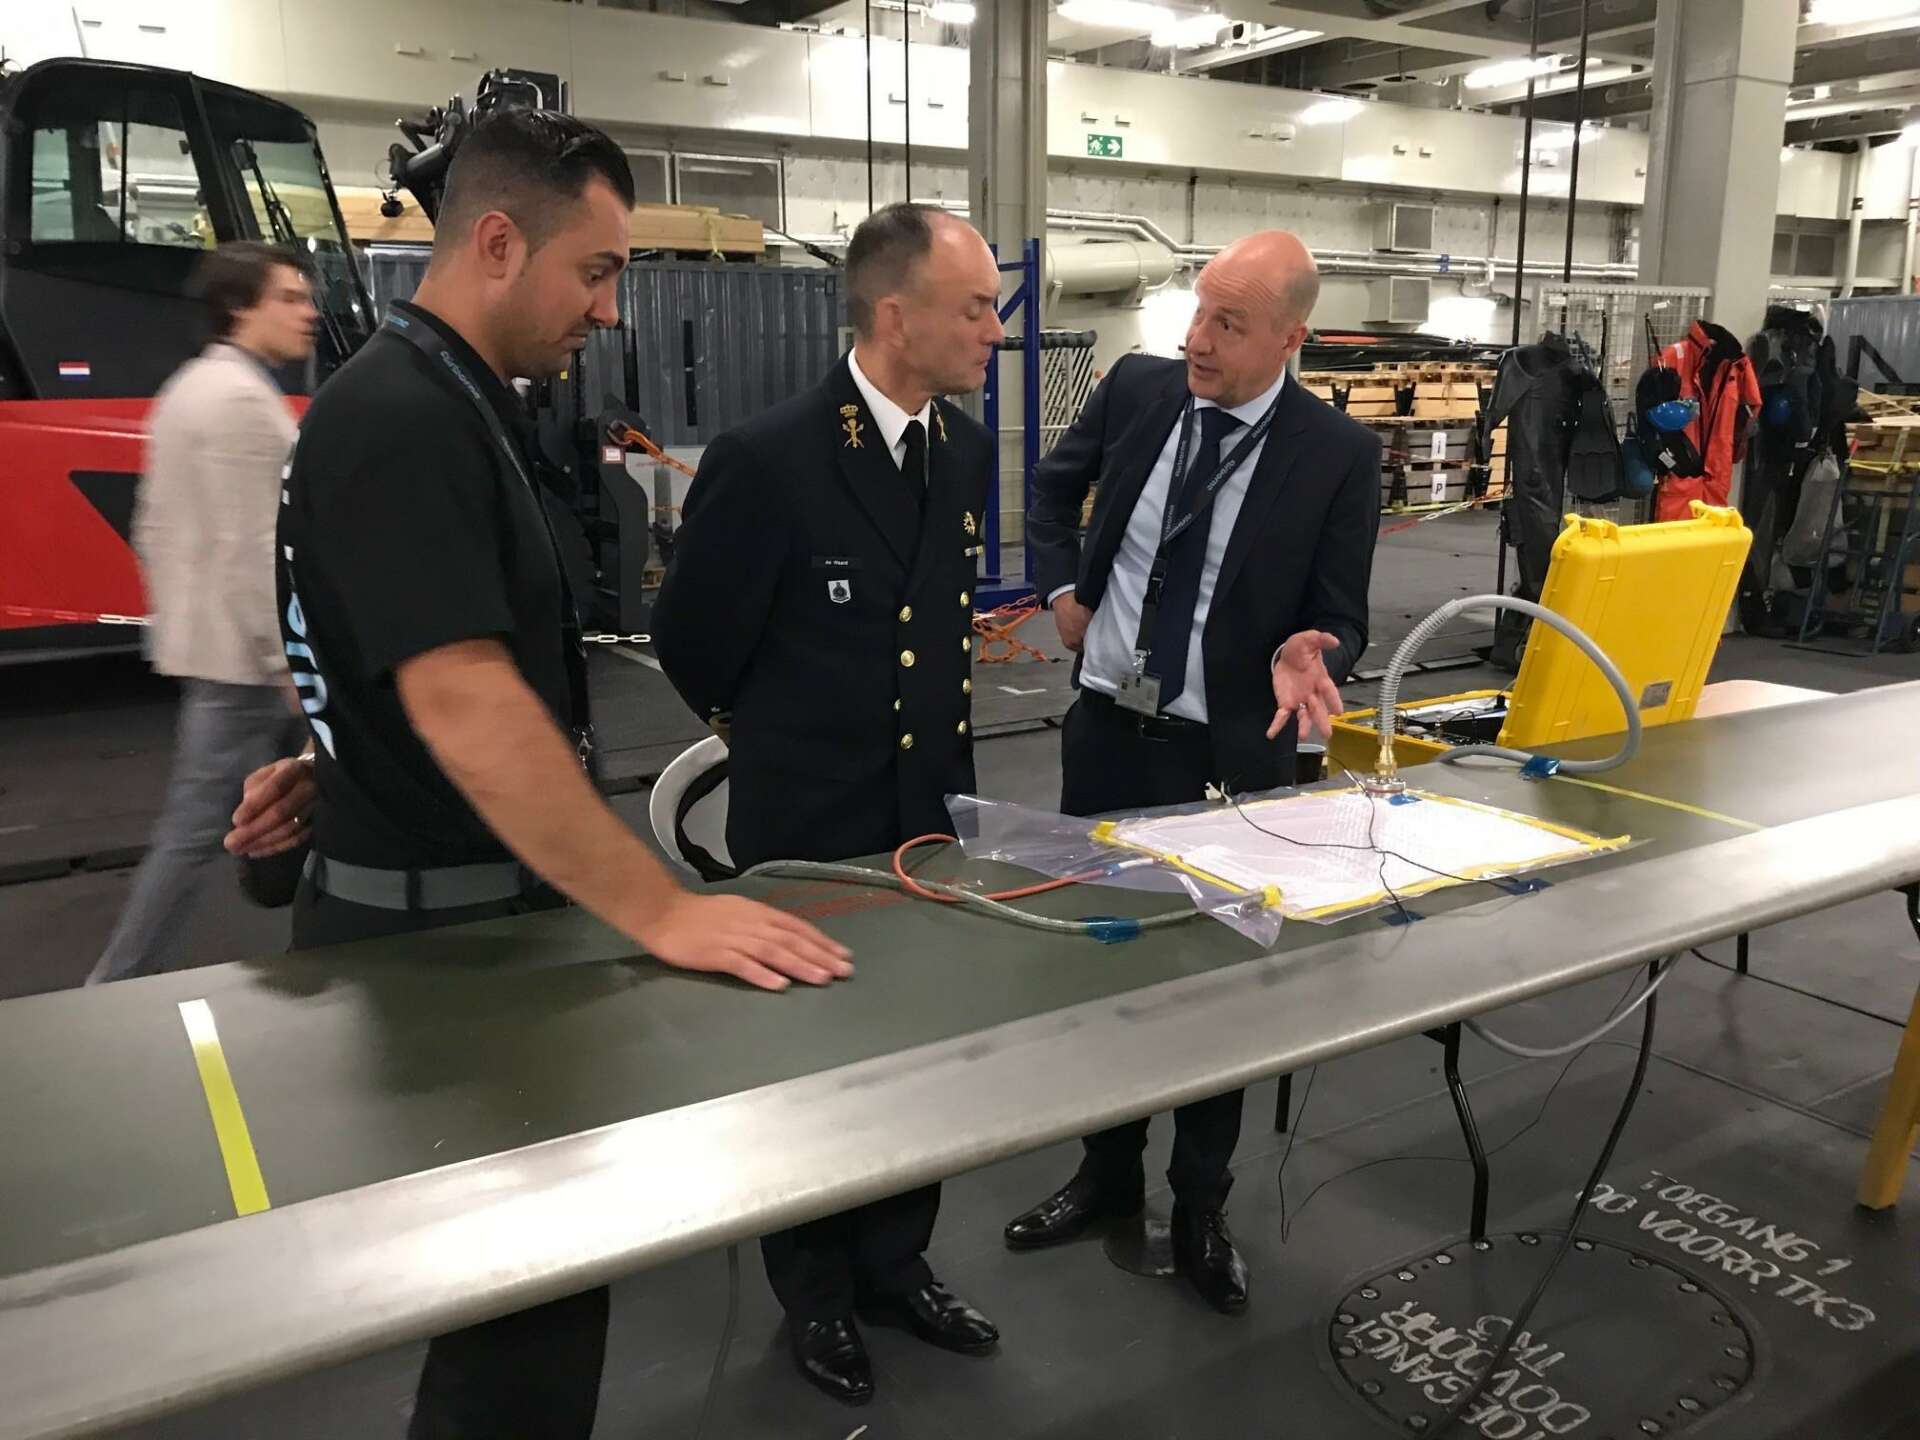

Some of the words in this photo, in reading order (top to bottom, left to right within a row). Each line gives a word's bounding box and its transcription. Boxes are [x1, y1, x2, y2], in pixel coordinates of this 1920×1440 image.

[1640, 1170, 1820, 1261] TOEGANG
[1816, 1258, 1852, 1275] 1
[1776, 1274, 1876, 1331] TK3
